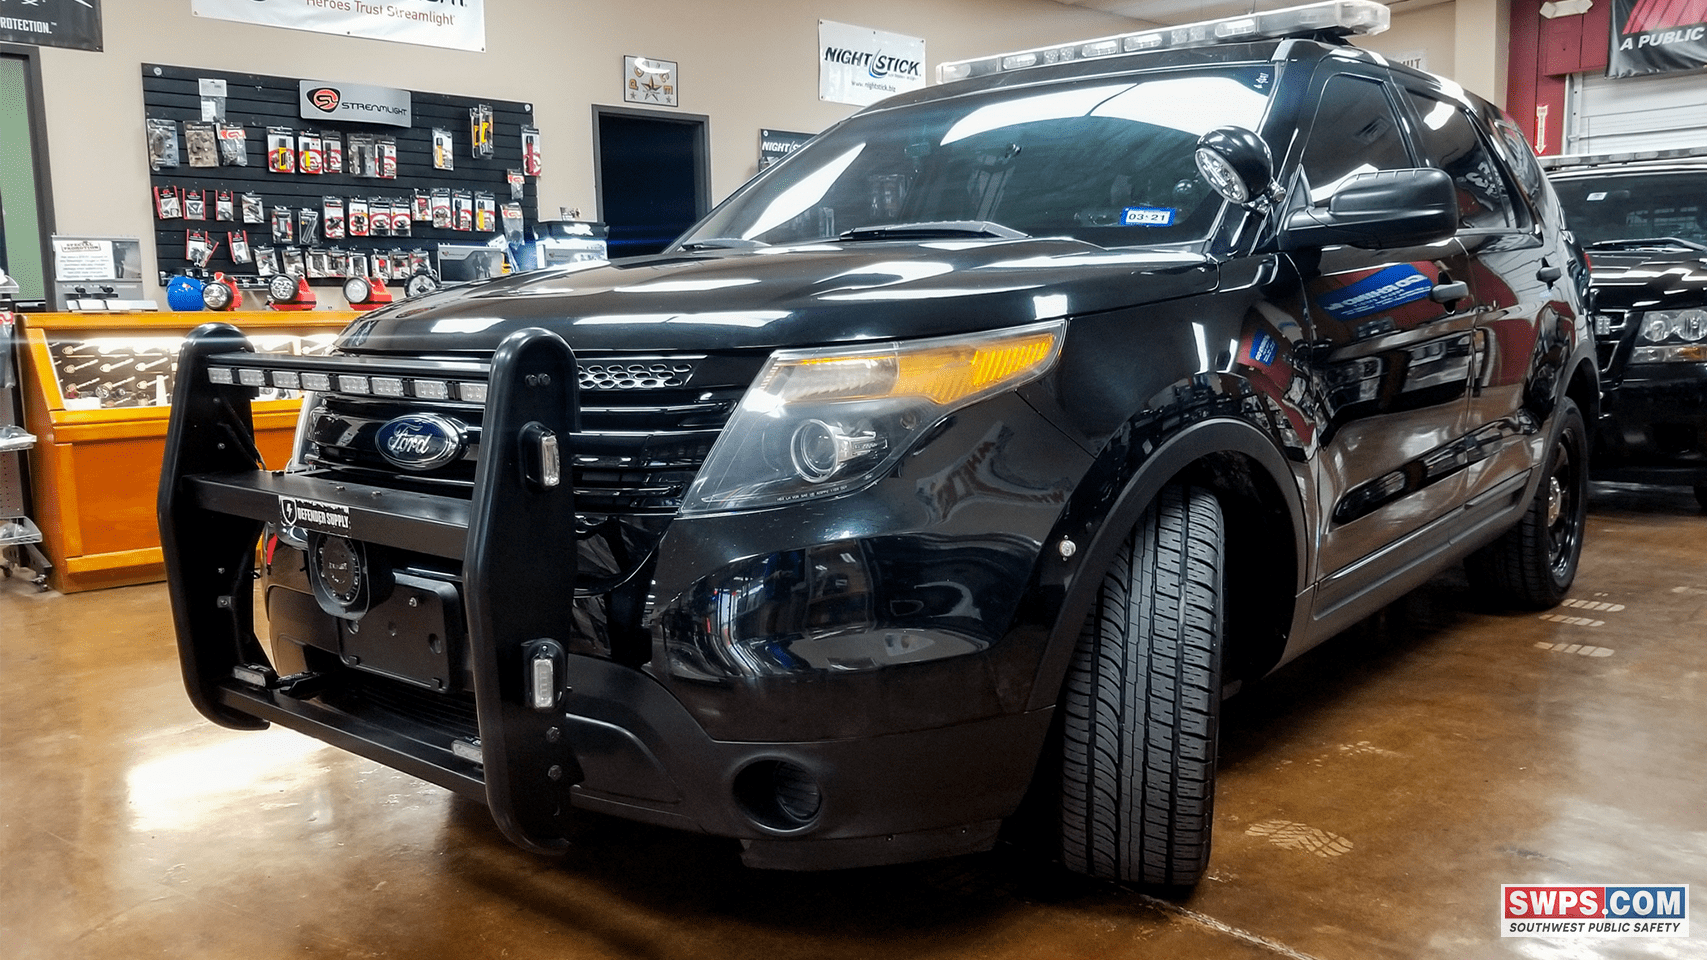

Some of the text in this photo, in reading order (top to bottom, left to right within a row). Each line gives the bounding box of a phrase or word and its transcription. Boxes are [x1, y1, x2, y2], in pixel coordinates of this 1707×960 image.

[354, 0, 383, 15] Trust
[386, 5, 454, 26] Streamlight
[0, 17, 52, 34] ROTECTION.
[1620, 27, 1705, 51] A PUBLIC
[341, 102, 407, 116] STREAMLIGHT
[387, 422, 433, 458] Ford
[297, 506, 349, 529] DEFENDER SUPPLY
